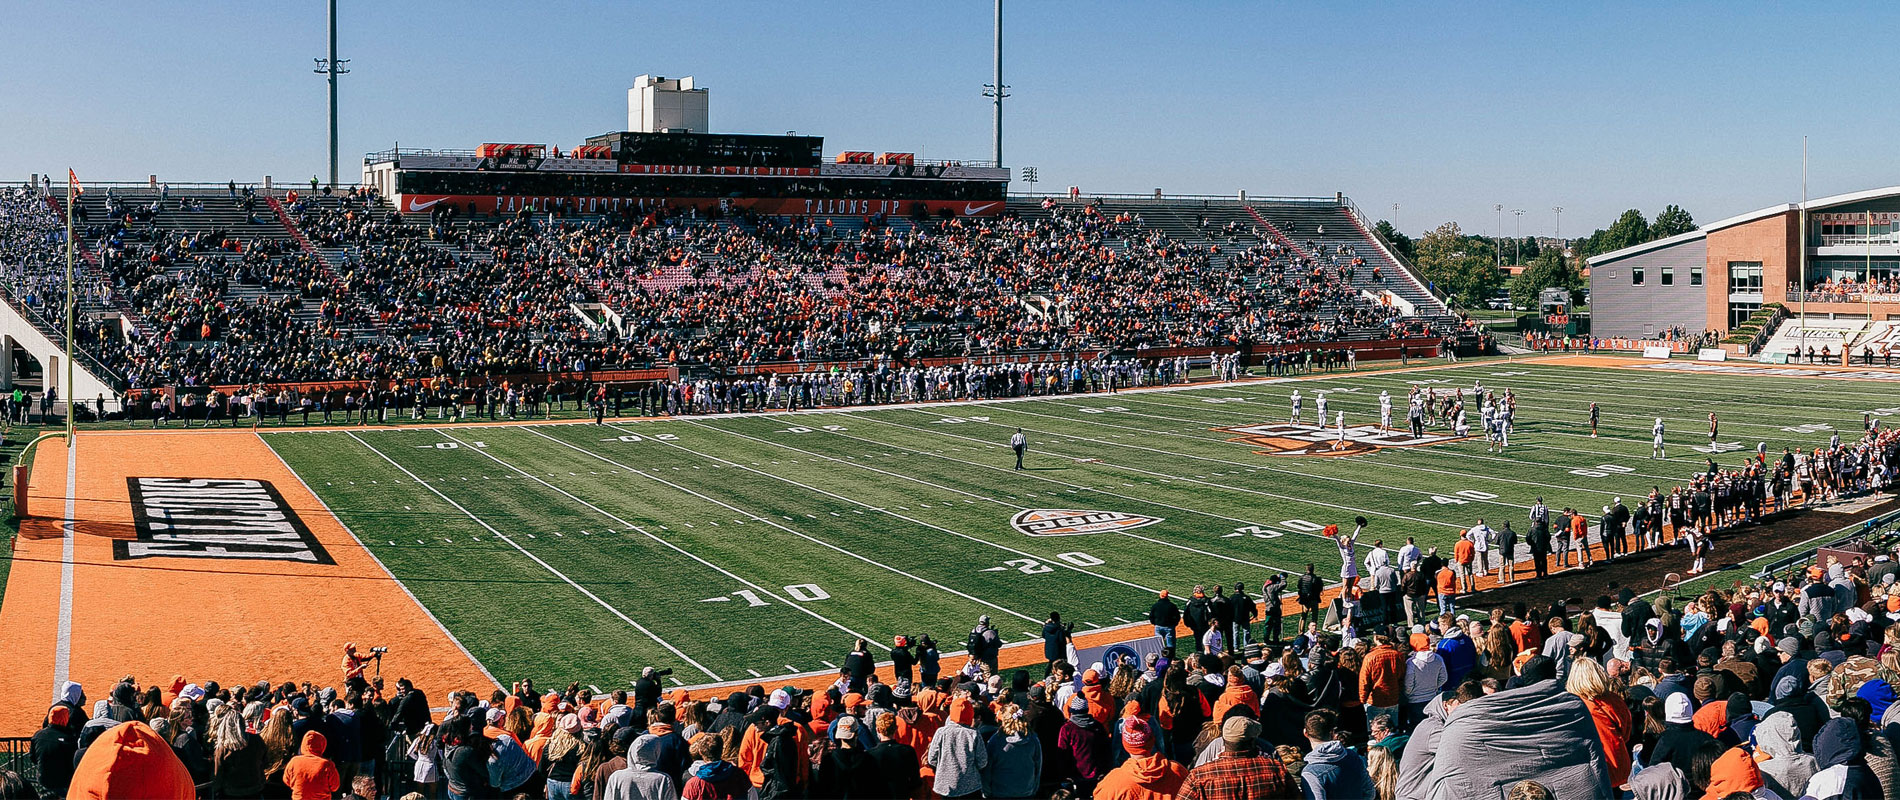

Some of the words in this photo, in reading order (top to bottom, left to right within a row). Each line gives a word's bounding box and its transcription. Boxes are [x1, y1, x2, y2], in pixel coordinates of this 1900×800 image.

[644, 164, 702, 174] WELCOME
[712, 166, 725, 175] TO
[735, 166, 759, 175] THE
[804, 200, 869, 214] TALONS
[880, 200, 901, 214] UP
[1556, 304, 1564, 315] 0
[967, 351, 1082, 364] FOOTBALL
[1568, 464, 1636, 478] 50
[1430, 490, 1499, 505] 40
[1672, 499, 1680, 509] 61
[1538, 507, 1545, 515] S
[127, 477, 318, 562] FALCONS
[1234, 519, 1326, 539] 30
[1003, 551, 1106, 575] 20
[731, 583, 831, 607] 10
[1106, 650, 1137, 670] Krer
